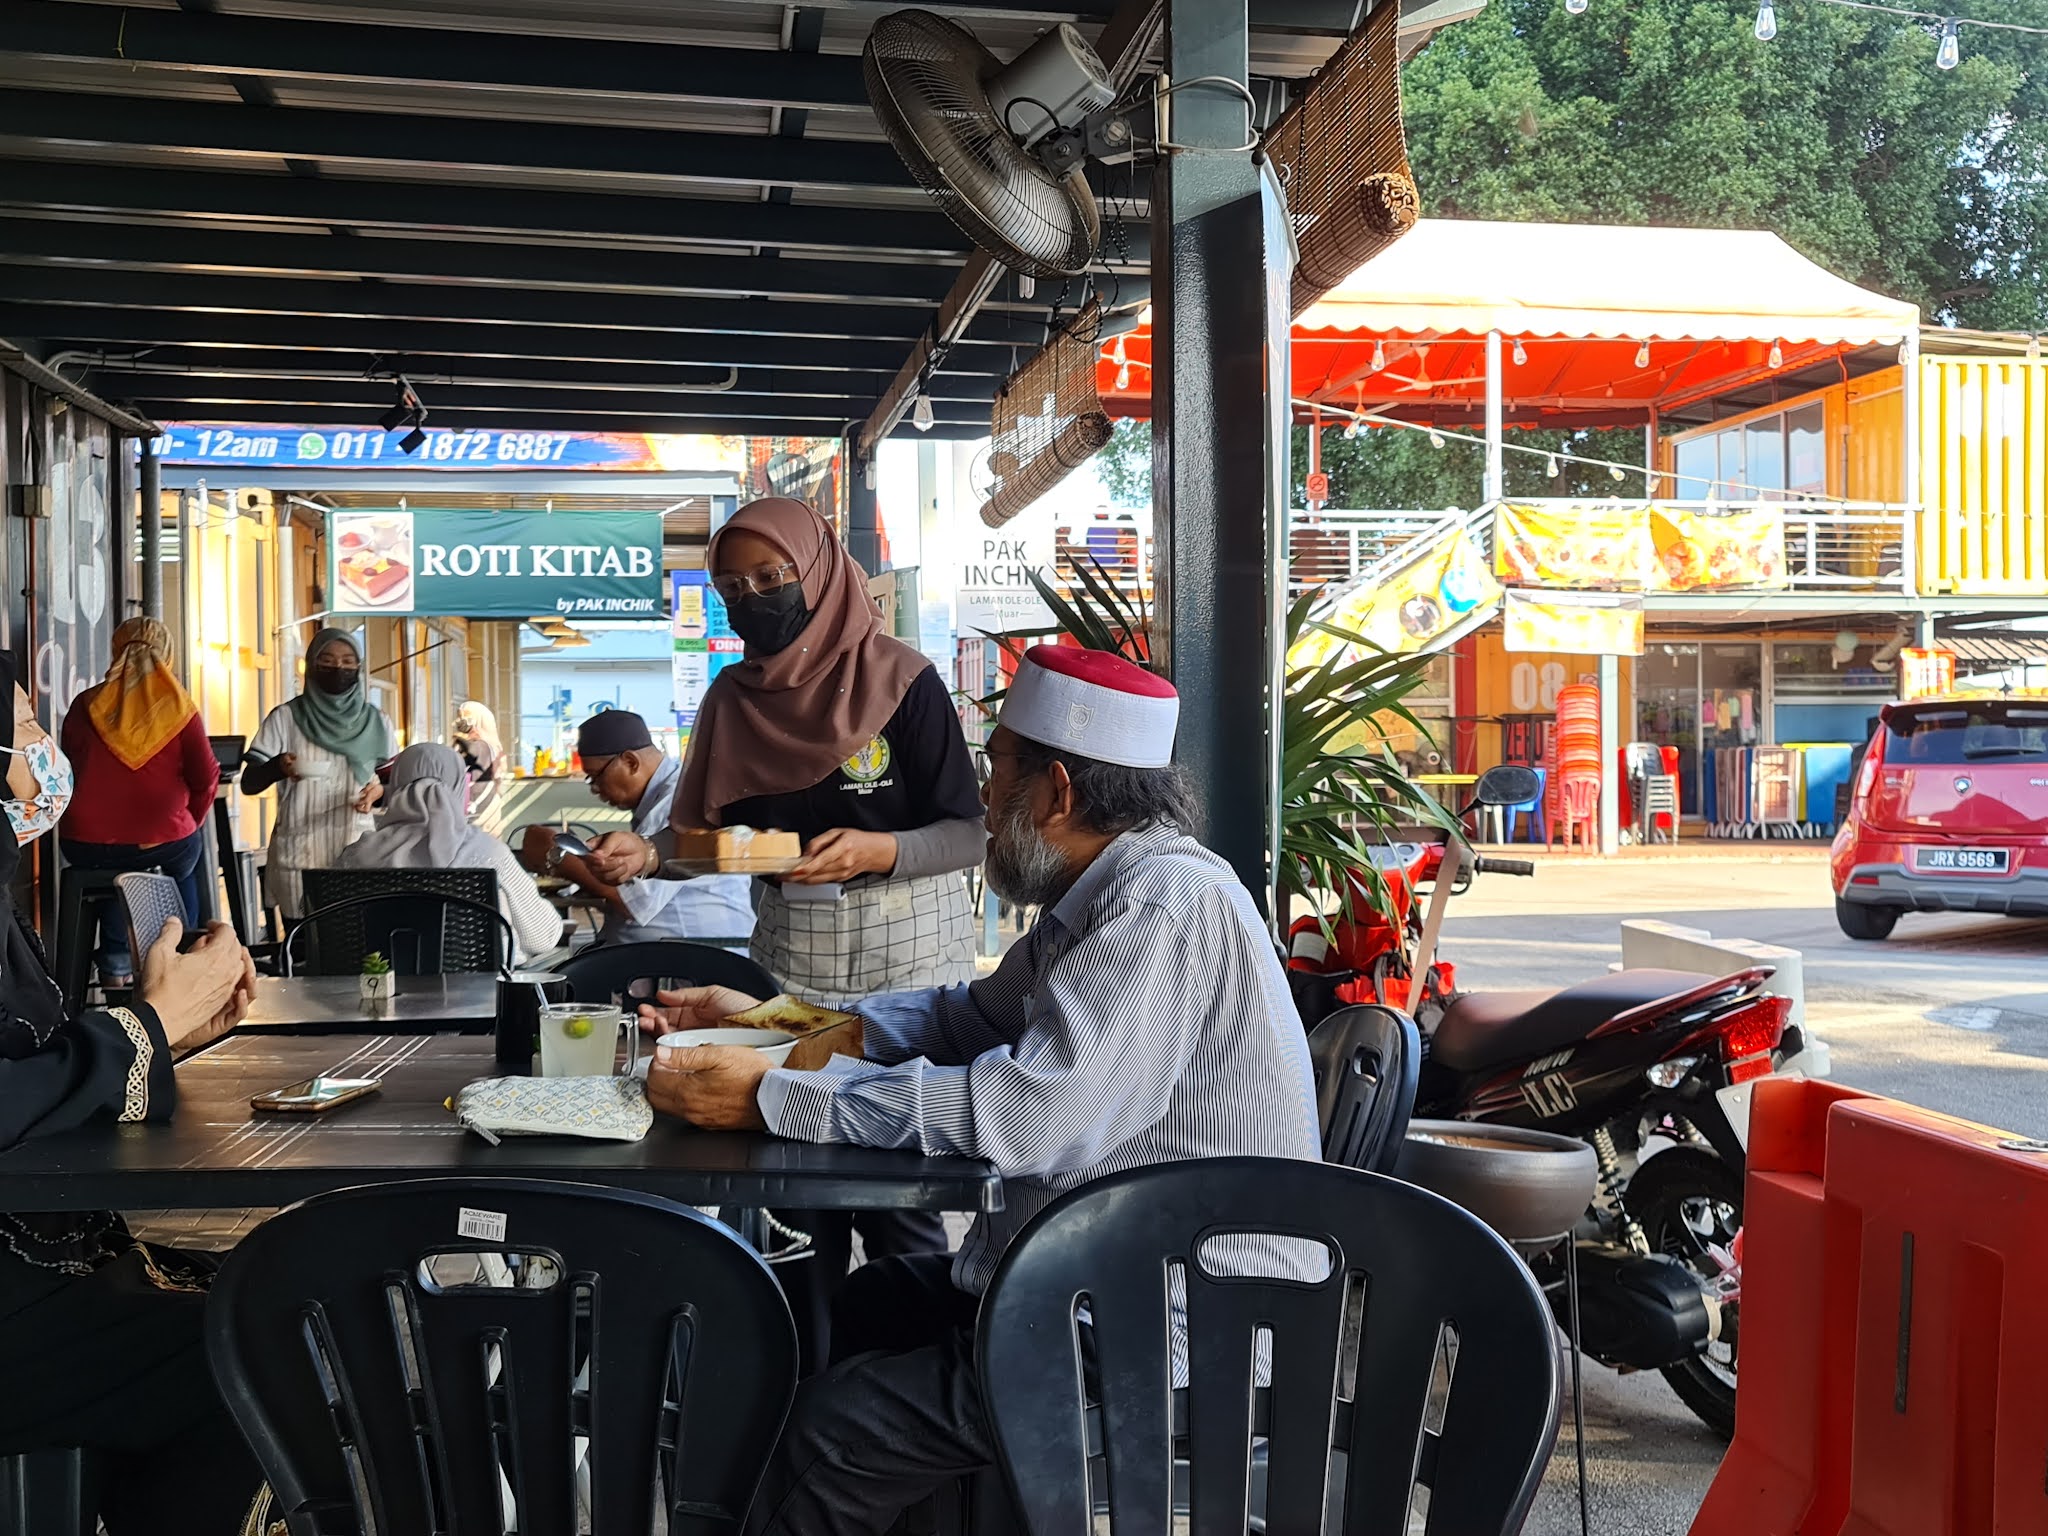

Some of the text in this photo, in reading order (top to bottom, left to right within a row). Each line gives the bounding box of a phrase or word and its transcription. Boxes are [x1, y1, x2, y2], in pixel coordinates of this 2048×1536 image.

[196, 430, 278, 458] 12am
[331, 432, 386, 460] 011
[418, 433, 490, 461] 1872
[497, 434, 570, 461] 6887
[983, 540, 1027, 560] PAK
[419, 544, 654, 577] ROTI KITAB
[556, 597, 655, 614] by PAK INCHIK
[970, 596, 1042, 605] LAMAN OLE-OLE
[1511, 662, 1566, 711] 08
[1928, 851, 1995, 867] JRX 9569
[367, 977, 379, 998] 9
